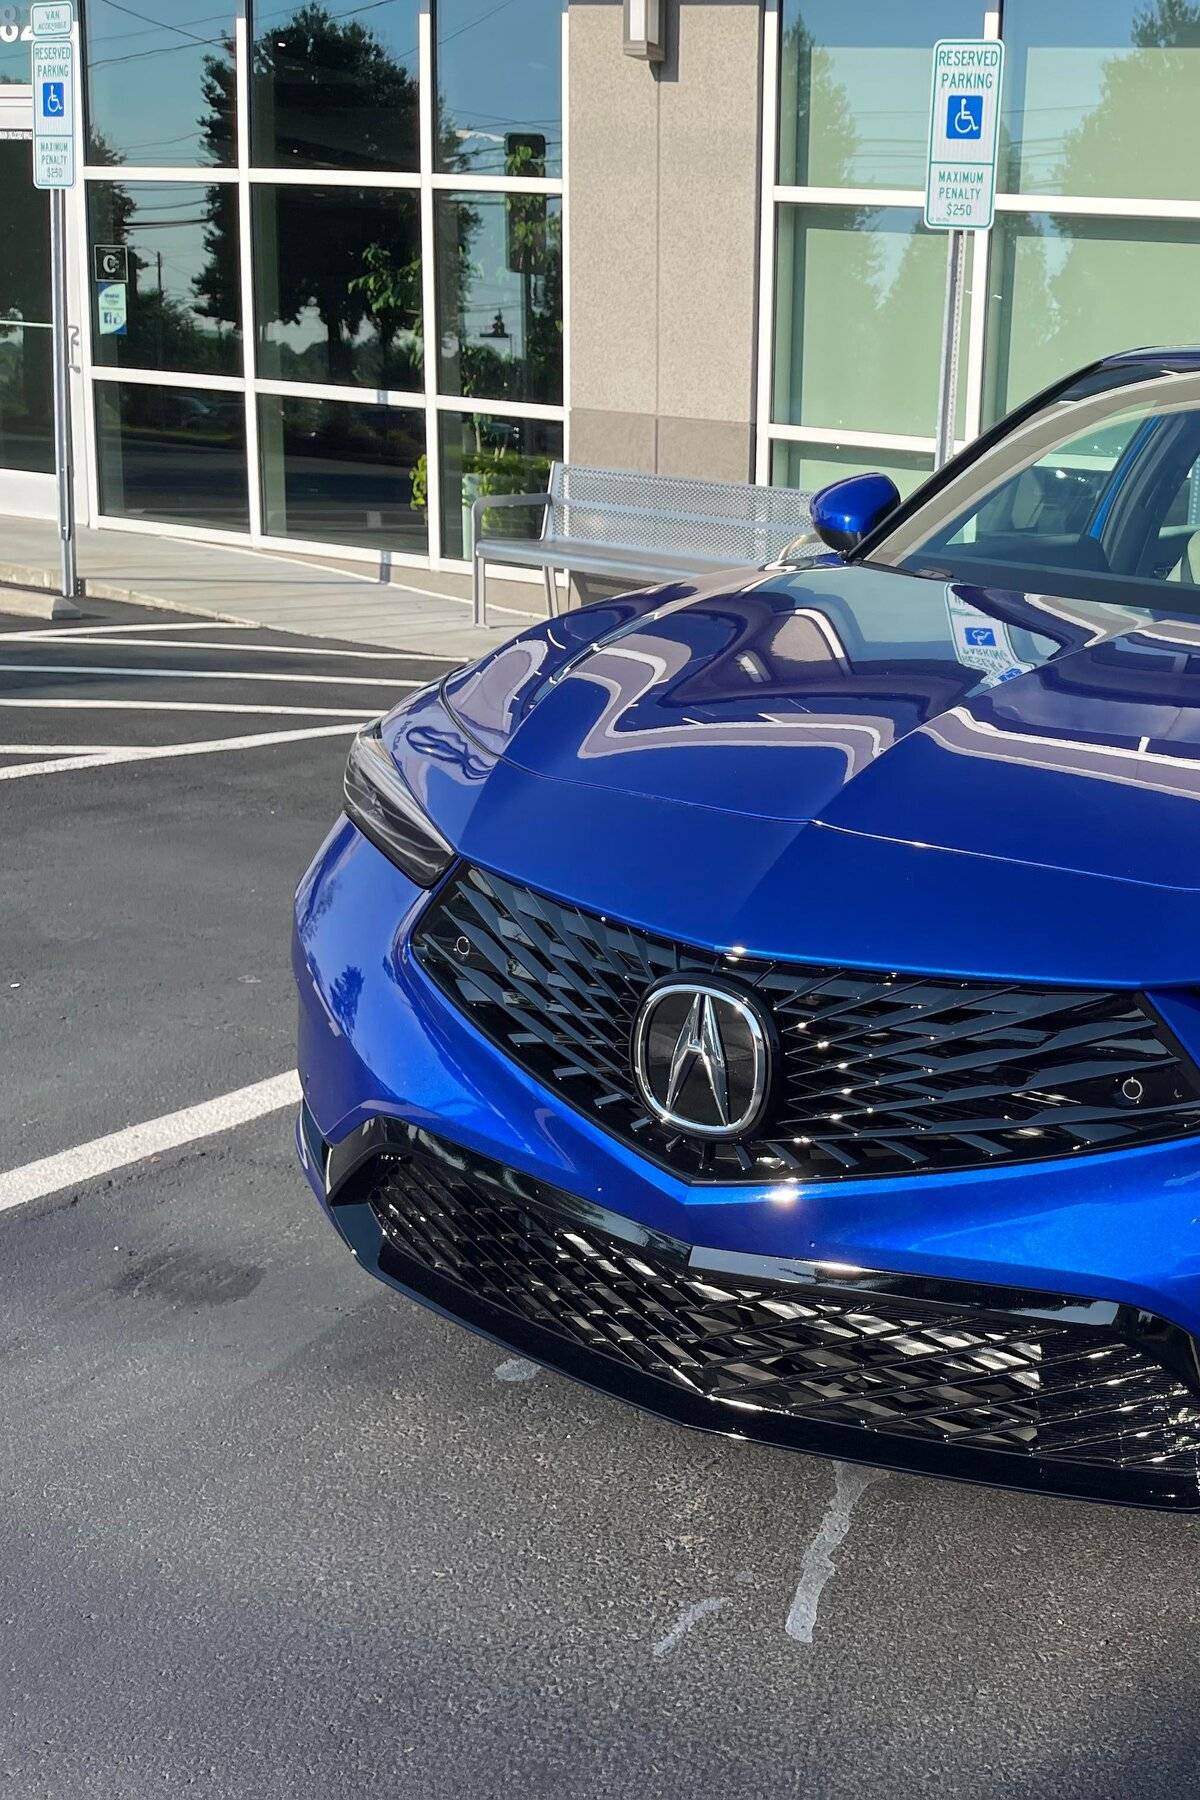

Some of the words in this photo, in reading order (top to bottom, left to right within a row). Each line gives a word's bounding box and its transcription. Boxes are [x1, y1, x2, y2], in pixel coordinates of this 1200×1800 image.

[45, 11, 60, 20] VAN
[35, 47, 70, 60] RESERVED
[938, 50, 998, 66] RESERVED
[37, 65, 69, 77] PARKING
[941, 73, 993, 89] PARKING
[40, 142, 68, 152] MAXIMUM
[41, 155, 67, 165] PENALTY
[938, 171, 984, 184] MAXIMUM
[939, 187, 981, 200] PENALTY
[946, 203, 972, 217] $250
